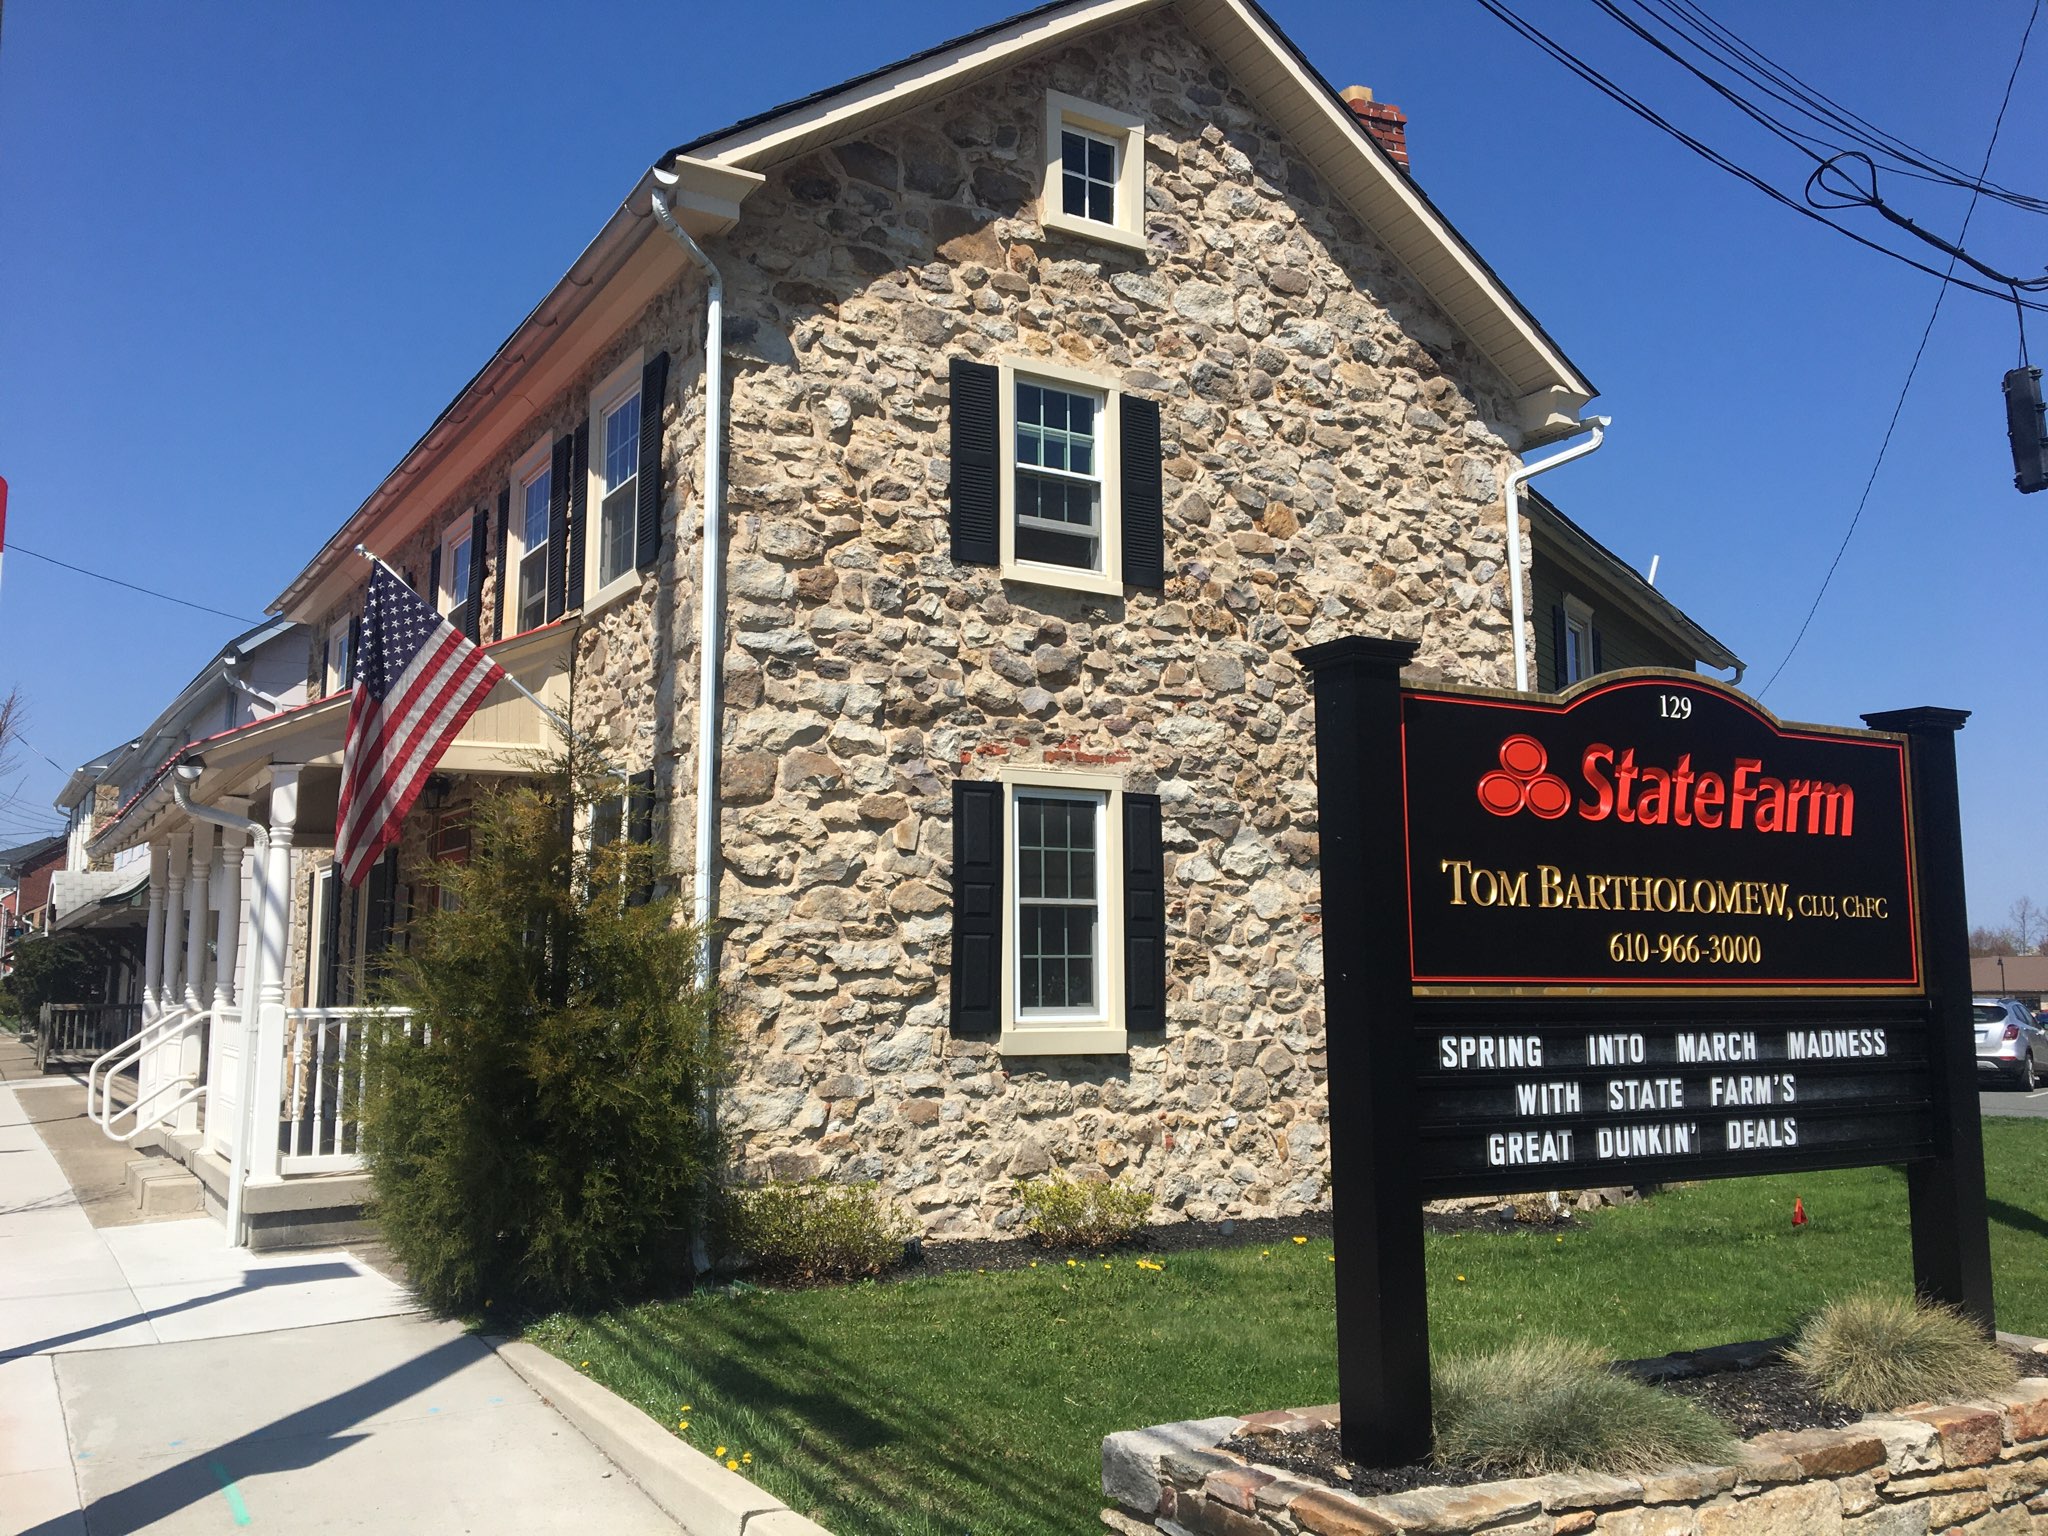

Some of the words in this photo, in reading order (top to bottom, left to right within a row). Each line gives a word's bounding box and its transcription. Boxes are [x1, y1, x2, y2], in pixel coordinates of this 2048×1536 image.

[1660, 694, 1692, 720] 129
[1441, 860, 1529, 908] TOM
[1537, 865, 1794, 921] BARTHOLOMEW,
[1799, 894, 1839, 920] CLU,
[1842, 895, 1887, 919] ChFC
[1610, 932, 1761, 964] 610-966-3000
[1441, 1036, 1542, 1068] SPRING
[1589, 1033, 1644, 1065] INTO
[1678, 1032, 1756, 1063] MARCH
[1789, 1028, 1886, 1059] MADNESS
[1517, 1082, 1579, 1115] WITH
[1609, 1078, 1683, 1111] STATE
[1711, 1074, 1795, 1106] FARM'S
[1489, 1130, 1573, 1165] GREAT
[1598, 1125, 1697, 1159] DUNKIN'
[1728, 1118, 1796, 1150] DEALS
